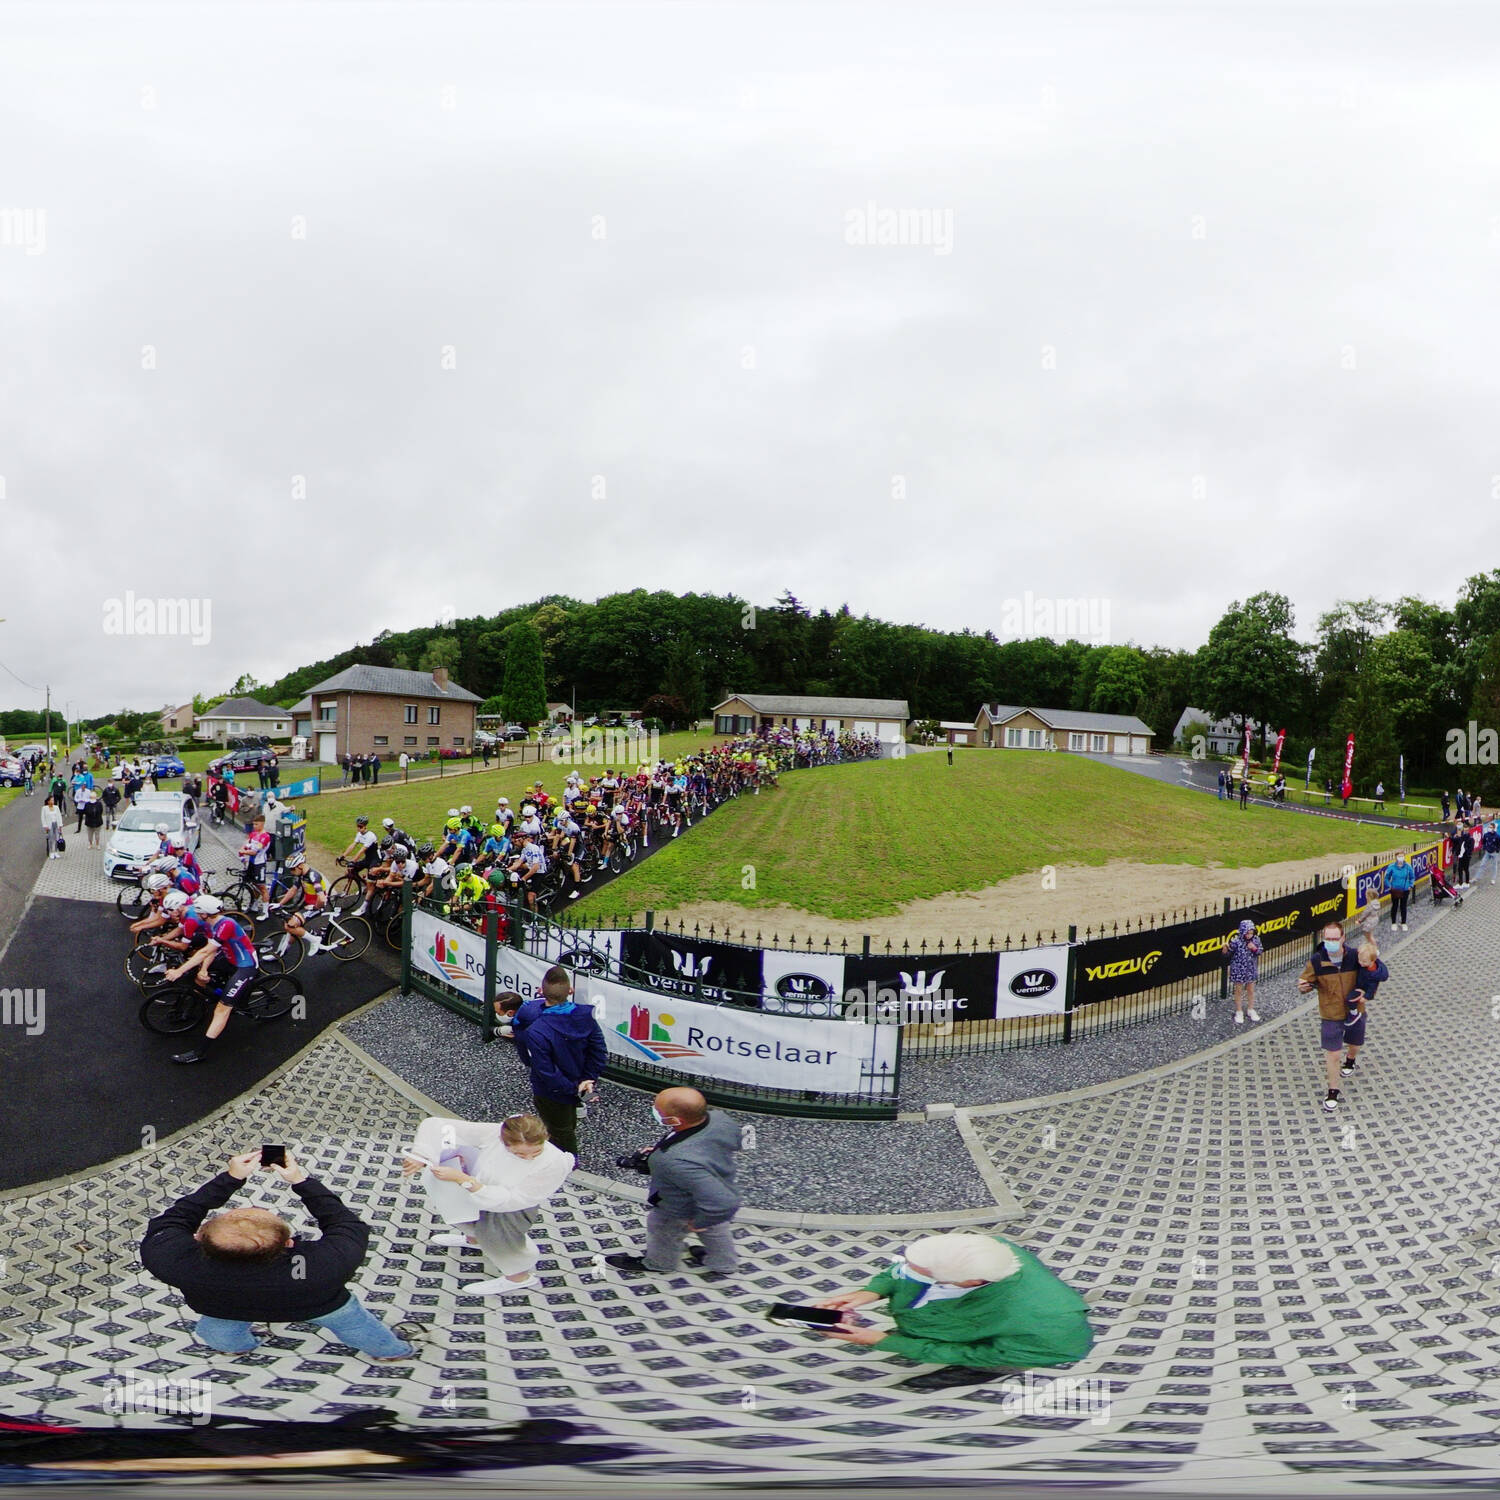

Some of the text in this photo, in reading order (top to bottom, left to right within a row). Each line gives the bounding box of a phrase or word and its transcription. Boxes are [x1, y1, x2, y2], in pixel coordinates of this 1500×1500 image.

[1182, 935, 1227, 959] YUZZU
[1085, 959, 1142, 981] YUZZU
[1016, 985, 1051, 994] vermarc
[876, 998, 969, 1012] vermarc
[687, 1027, 838, 1065] Rotselaar
